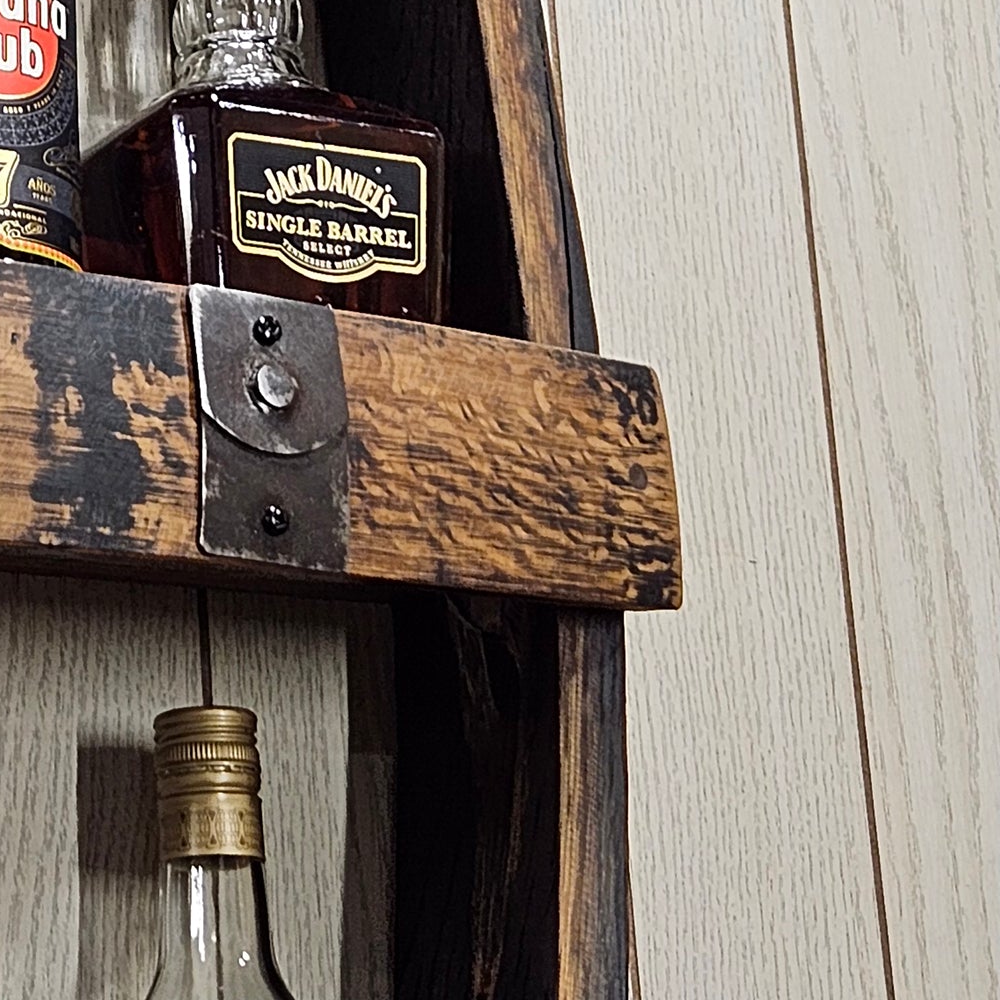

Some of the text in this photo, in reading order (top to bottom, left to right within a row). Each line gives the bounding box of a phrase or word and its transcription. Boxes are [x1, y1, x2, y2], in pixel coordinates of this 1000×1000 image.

[27, 176, 57, 197] AÑOS
[264, 155, 398, 219] JACK DANIEL'S
[245, 209, 413, 250] SINGLE BARREL
[281, 237, 333, 270] TENNESSEE
[302, 240, 352, 257] SELECT
